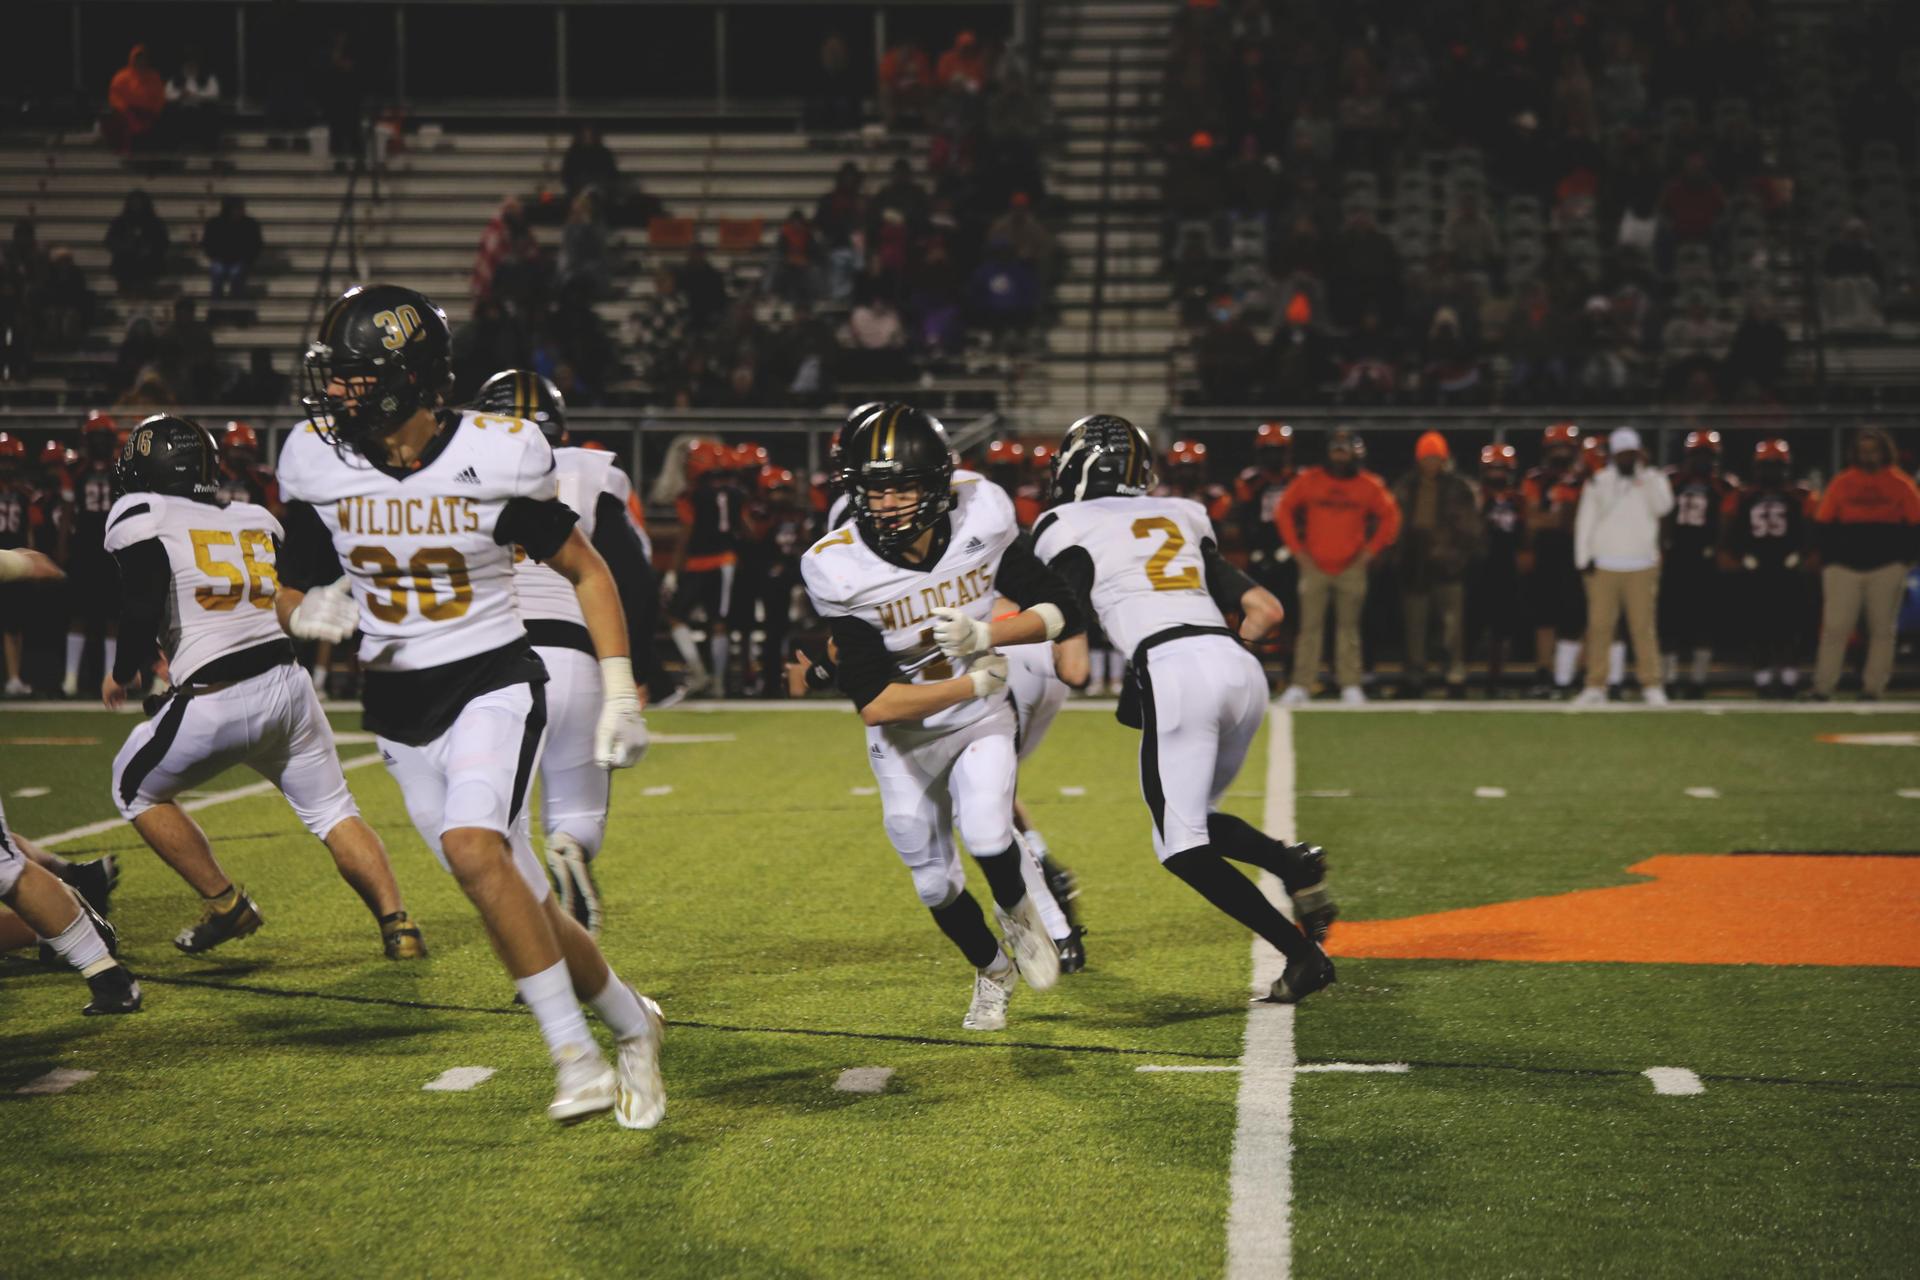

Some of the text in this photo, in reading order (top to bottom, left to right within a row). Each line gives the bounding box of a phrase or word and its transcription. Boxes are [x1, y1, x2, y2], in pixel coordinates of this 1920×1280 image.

[373, 304, 426, 351] 30
[85, 483, 111, 511] 21
[336, 496, 481, 536] WILDCATS
[717, 492, 730, 532] 1
[814, 528, 855, 555] 7
[1131, 515, 1201, 592] 2
[189, 529, 280, 612] 56
[349, 545, 474, 624] 30
[874, 562, 995, 632] WILDCATS
